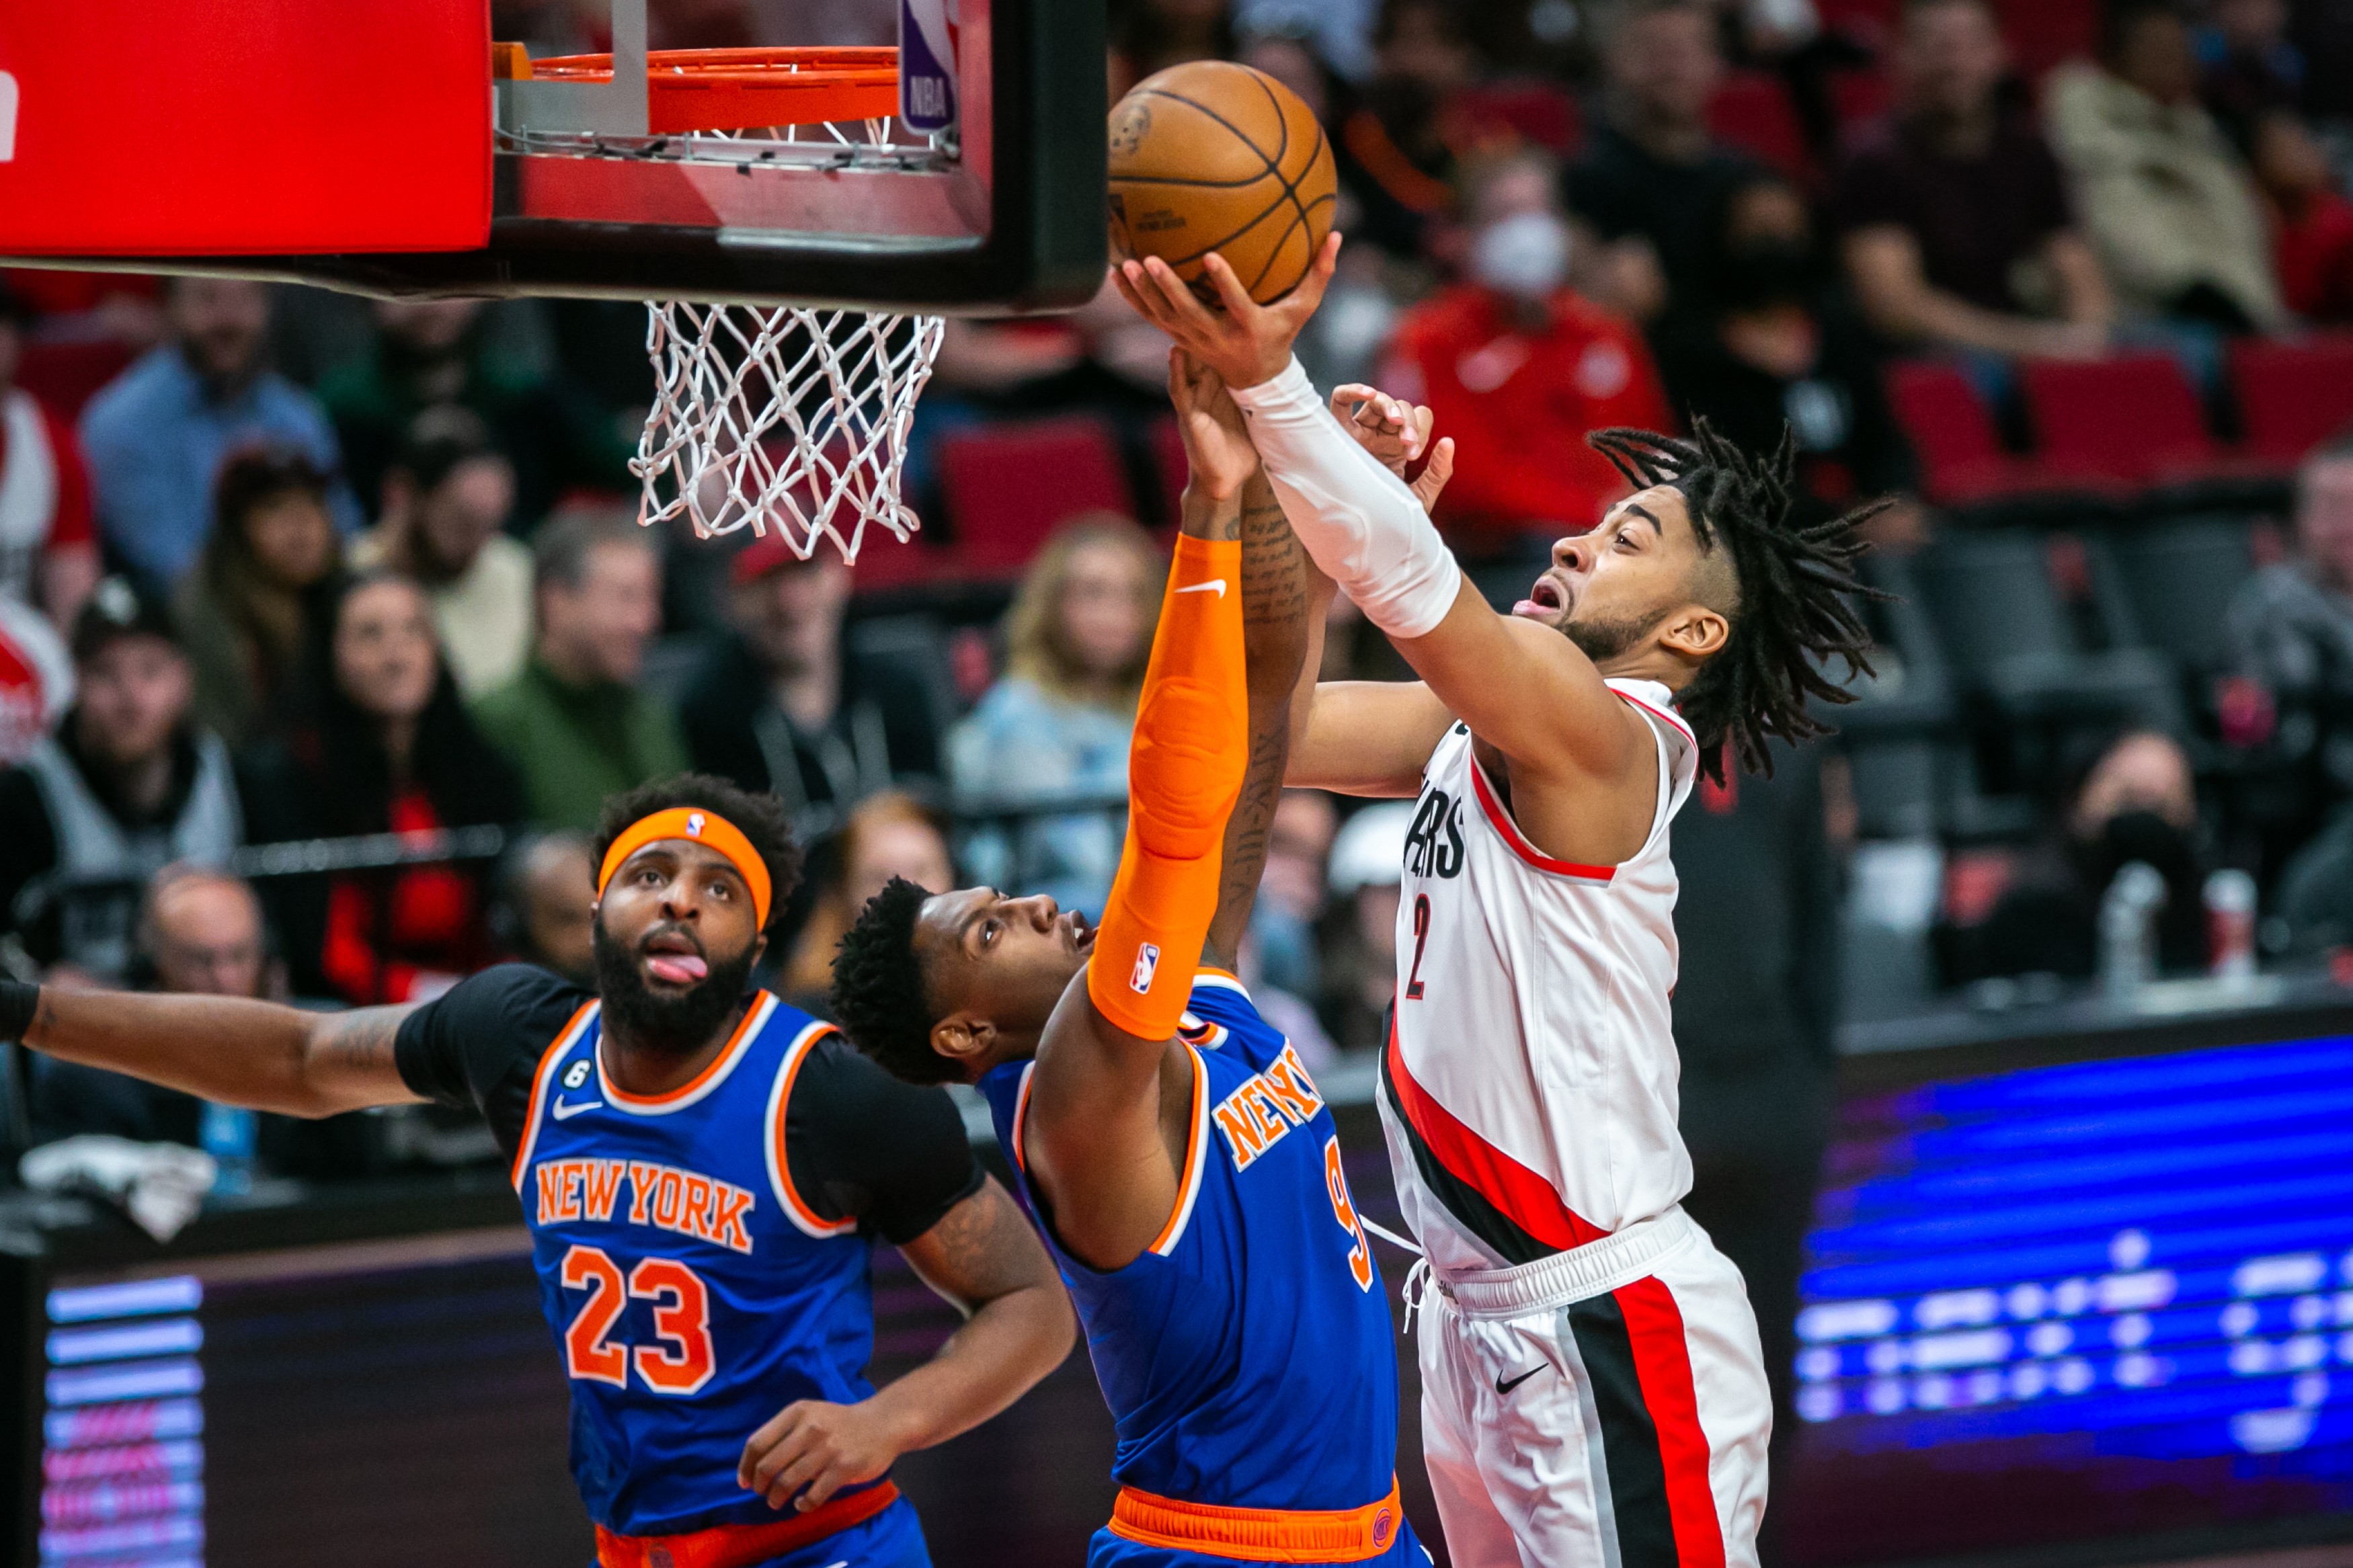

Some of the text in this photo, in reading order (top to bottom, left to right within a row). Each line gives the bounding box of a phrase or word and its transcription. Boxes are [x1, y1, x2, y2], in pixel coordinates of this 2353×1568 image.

[910, 75, 947, 118] NBA
[1406, 893, 1431, 1000] 2
[563, 1059, 592, 1089] 6
[536, 1157, 756, 1255] NEW YORK
[1324, 1134, 1374, 1294] 9
[561, 1243, 717, 1396] 23
